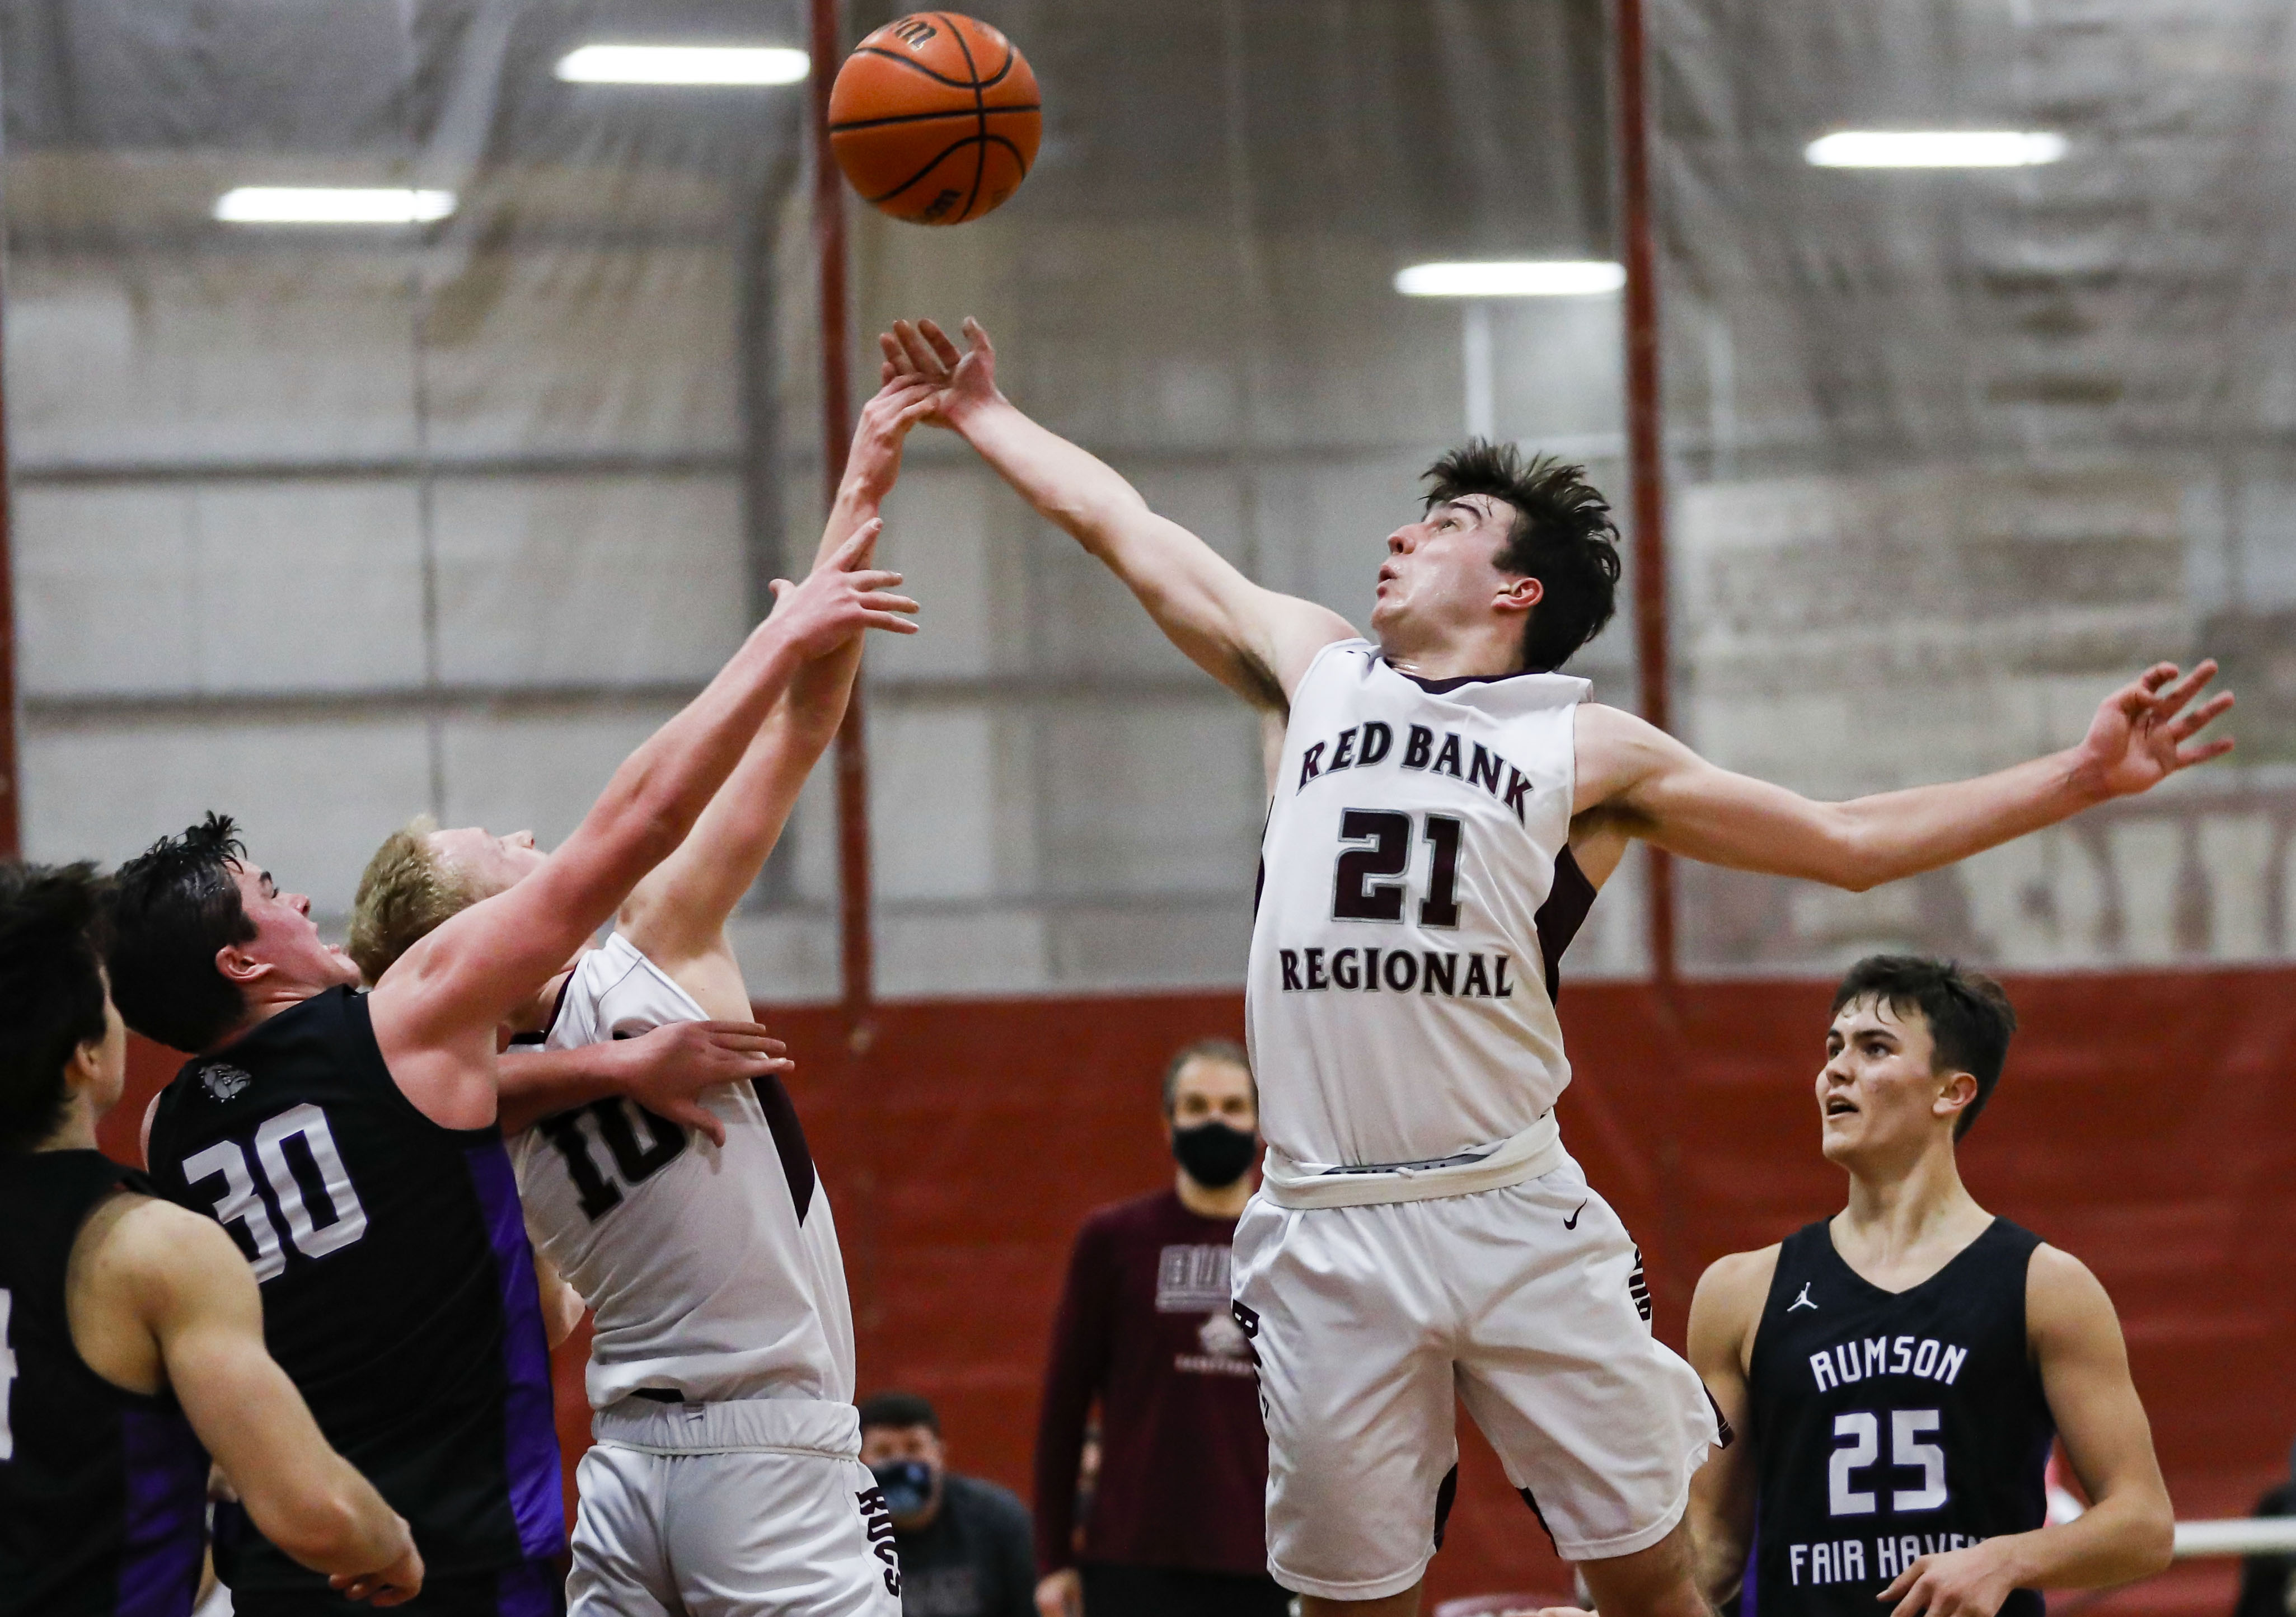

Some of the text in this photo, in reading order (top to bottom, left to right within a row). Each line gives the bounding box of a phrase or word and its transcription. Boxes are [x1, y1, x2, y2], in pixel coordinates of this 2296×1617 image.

[1296, 720, 1534, 829] RED BANK
[1330, 807, 1464, 931] 21
[1280, 946, 1514, 999] REGIONAL
[182, 1103, 368, 1284] 30
[1809, 1335, 1968, 1393] RUMSON
[1829, 1409, 1949, 1516] 25
[1789, 1532, 1986, 1586] FAIR HAV
